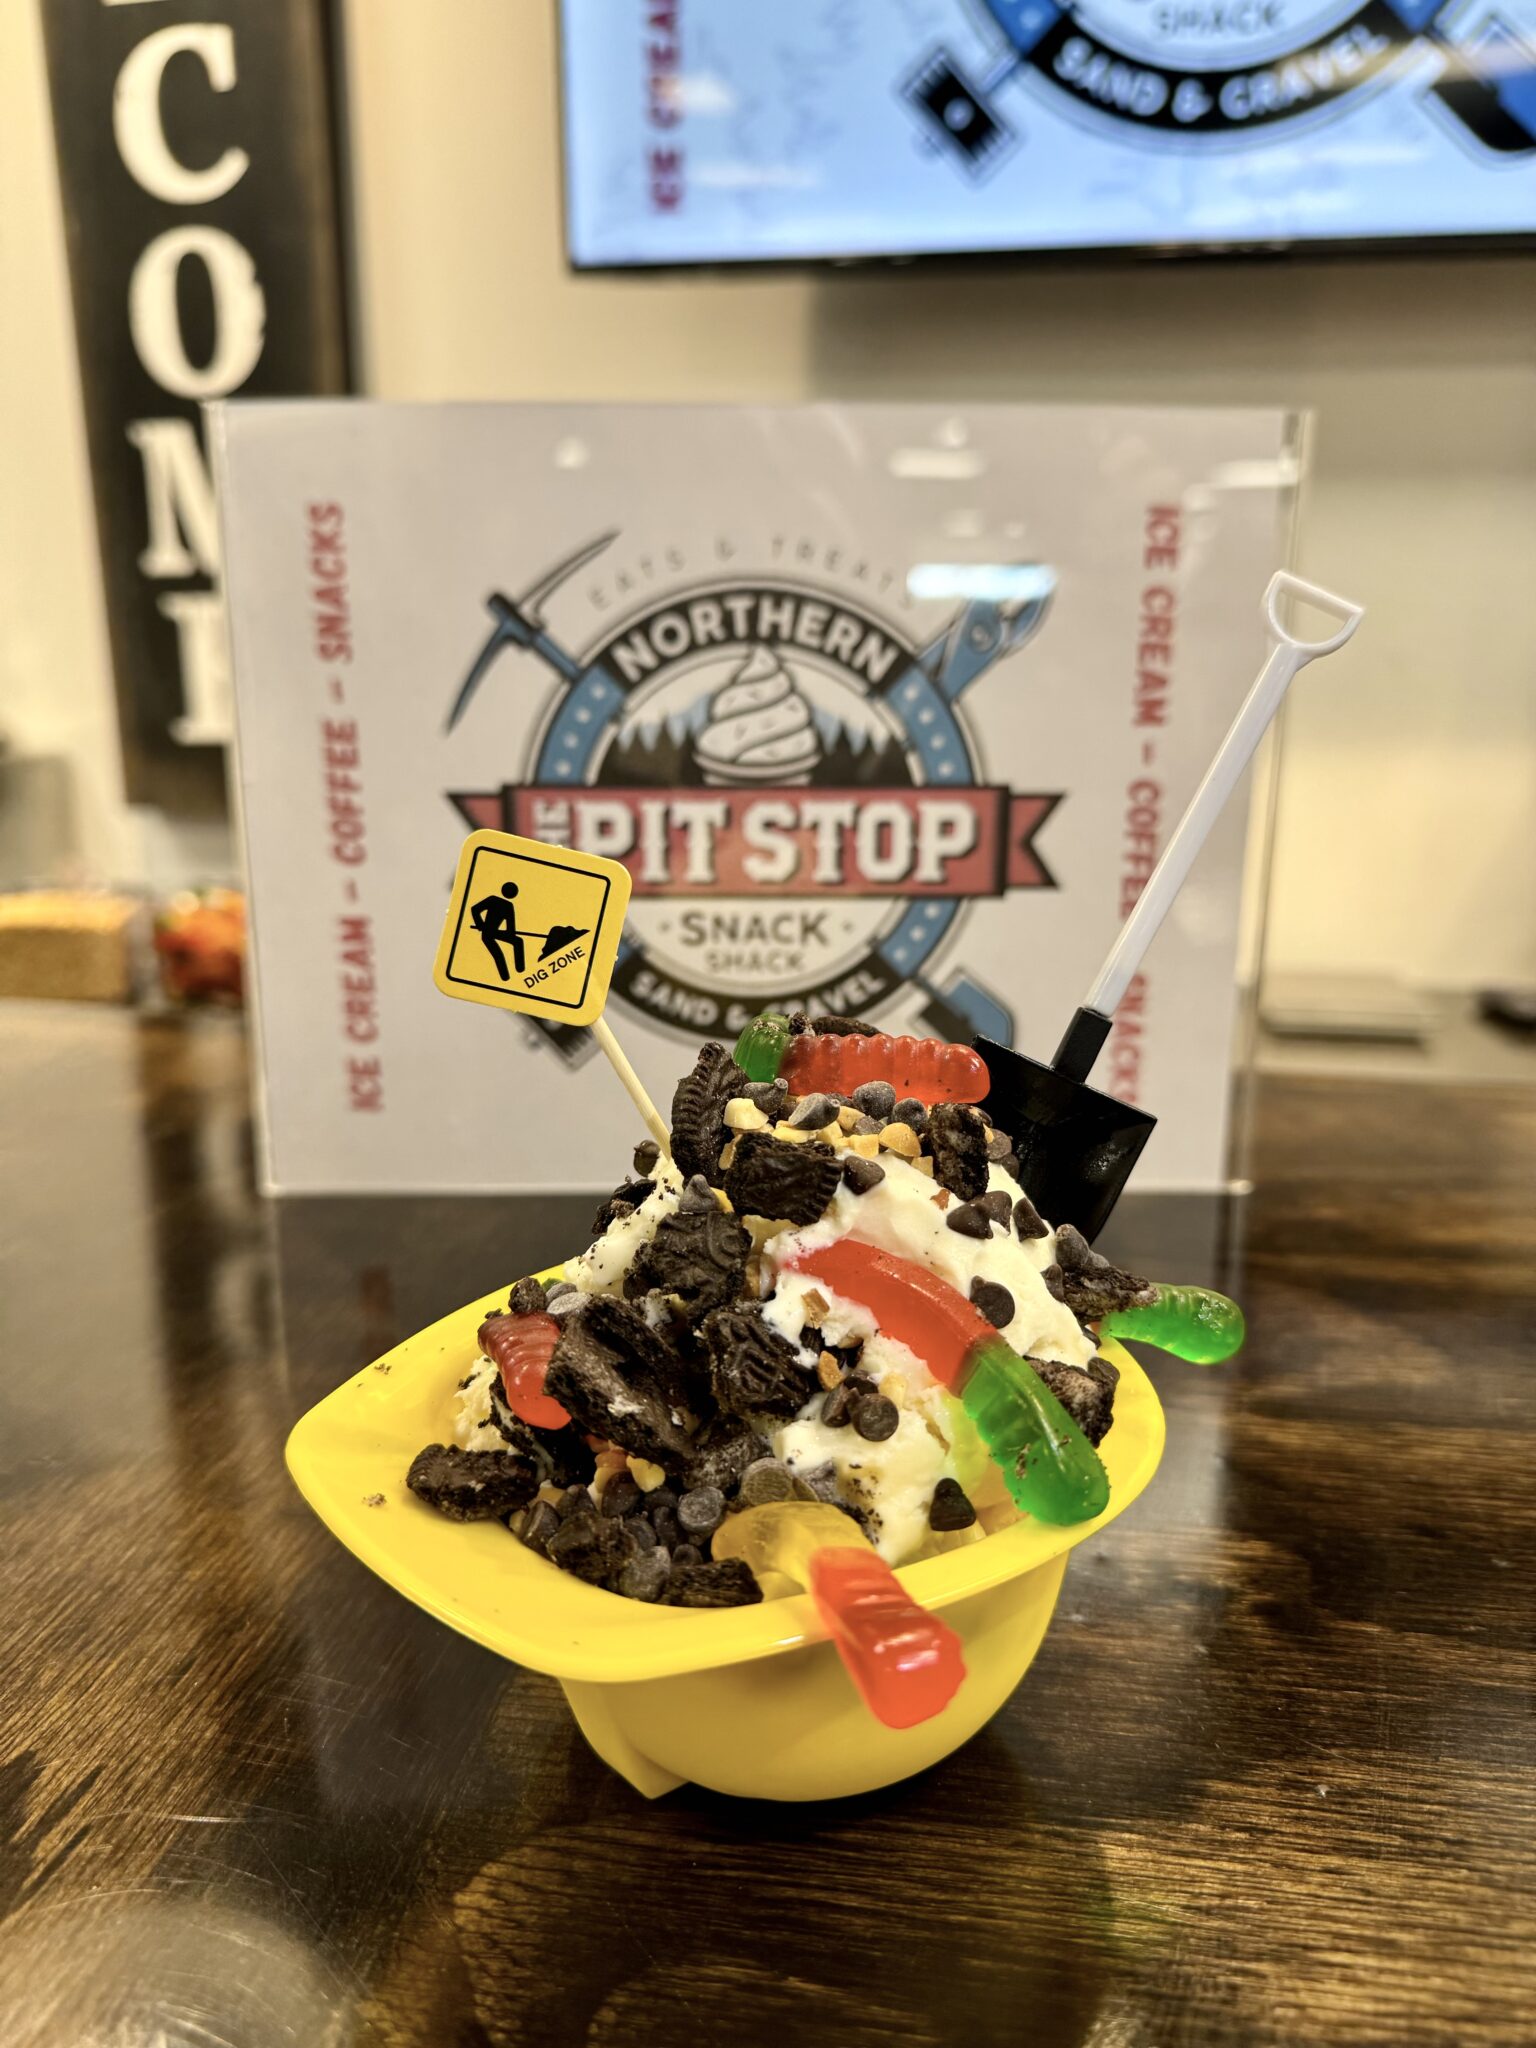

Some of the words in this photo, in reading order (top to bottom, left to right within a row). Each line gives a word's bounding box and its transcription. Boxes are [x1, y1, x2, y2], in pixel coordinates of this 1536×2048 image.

[1053, 37, 1168, 117] SAND
[1171, 78, 1213, 123] &
[1219, 24, 1390, 120] GRAVEL
[771, 534, 914, 610] TREAT
[1144, 504, 1180, 570] ICE
[309, 502, 353, 664] SNACKS
[610, 594, 899, 684] NORTHERN
[1132, 586, 1175, 728] CREAM
[322, 718, 367, 865] COFFEE
[574, 800, 727, 884] PIT
[741, 799, 978, 885] STOP
[523, 968, 549, 989] DIG
[548, 946, 586, 974] ZONE
[680, 910, 829, 947] SNACK
[704, 951, 804, 973] SHACK
[341, 915, 379, 1044] CREAM
[628, 968, 720, 1027] SAND
[346, 1056, 384, 1112] ICE
